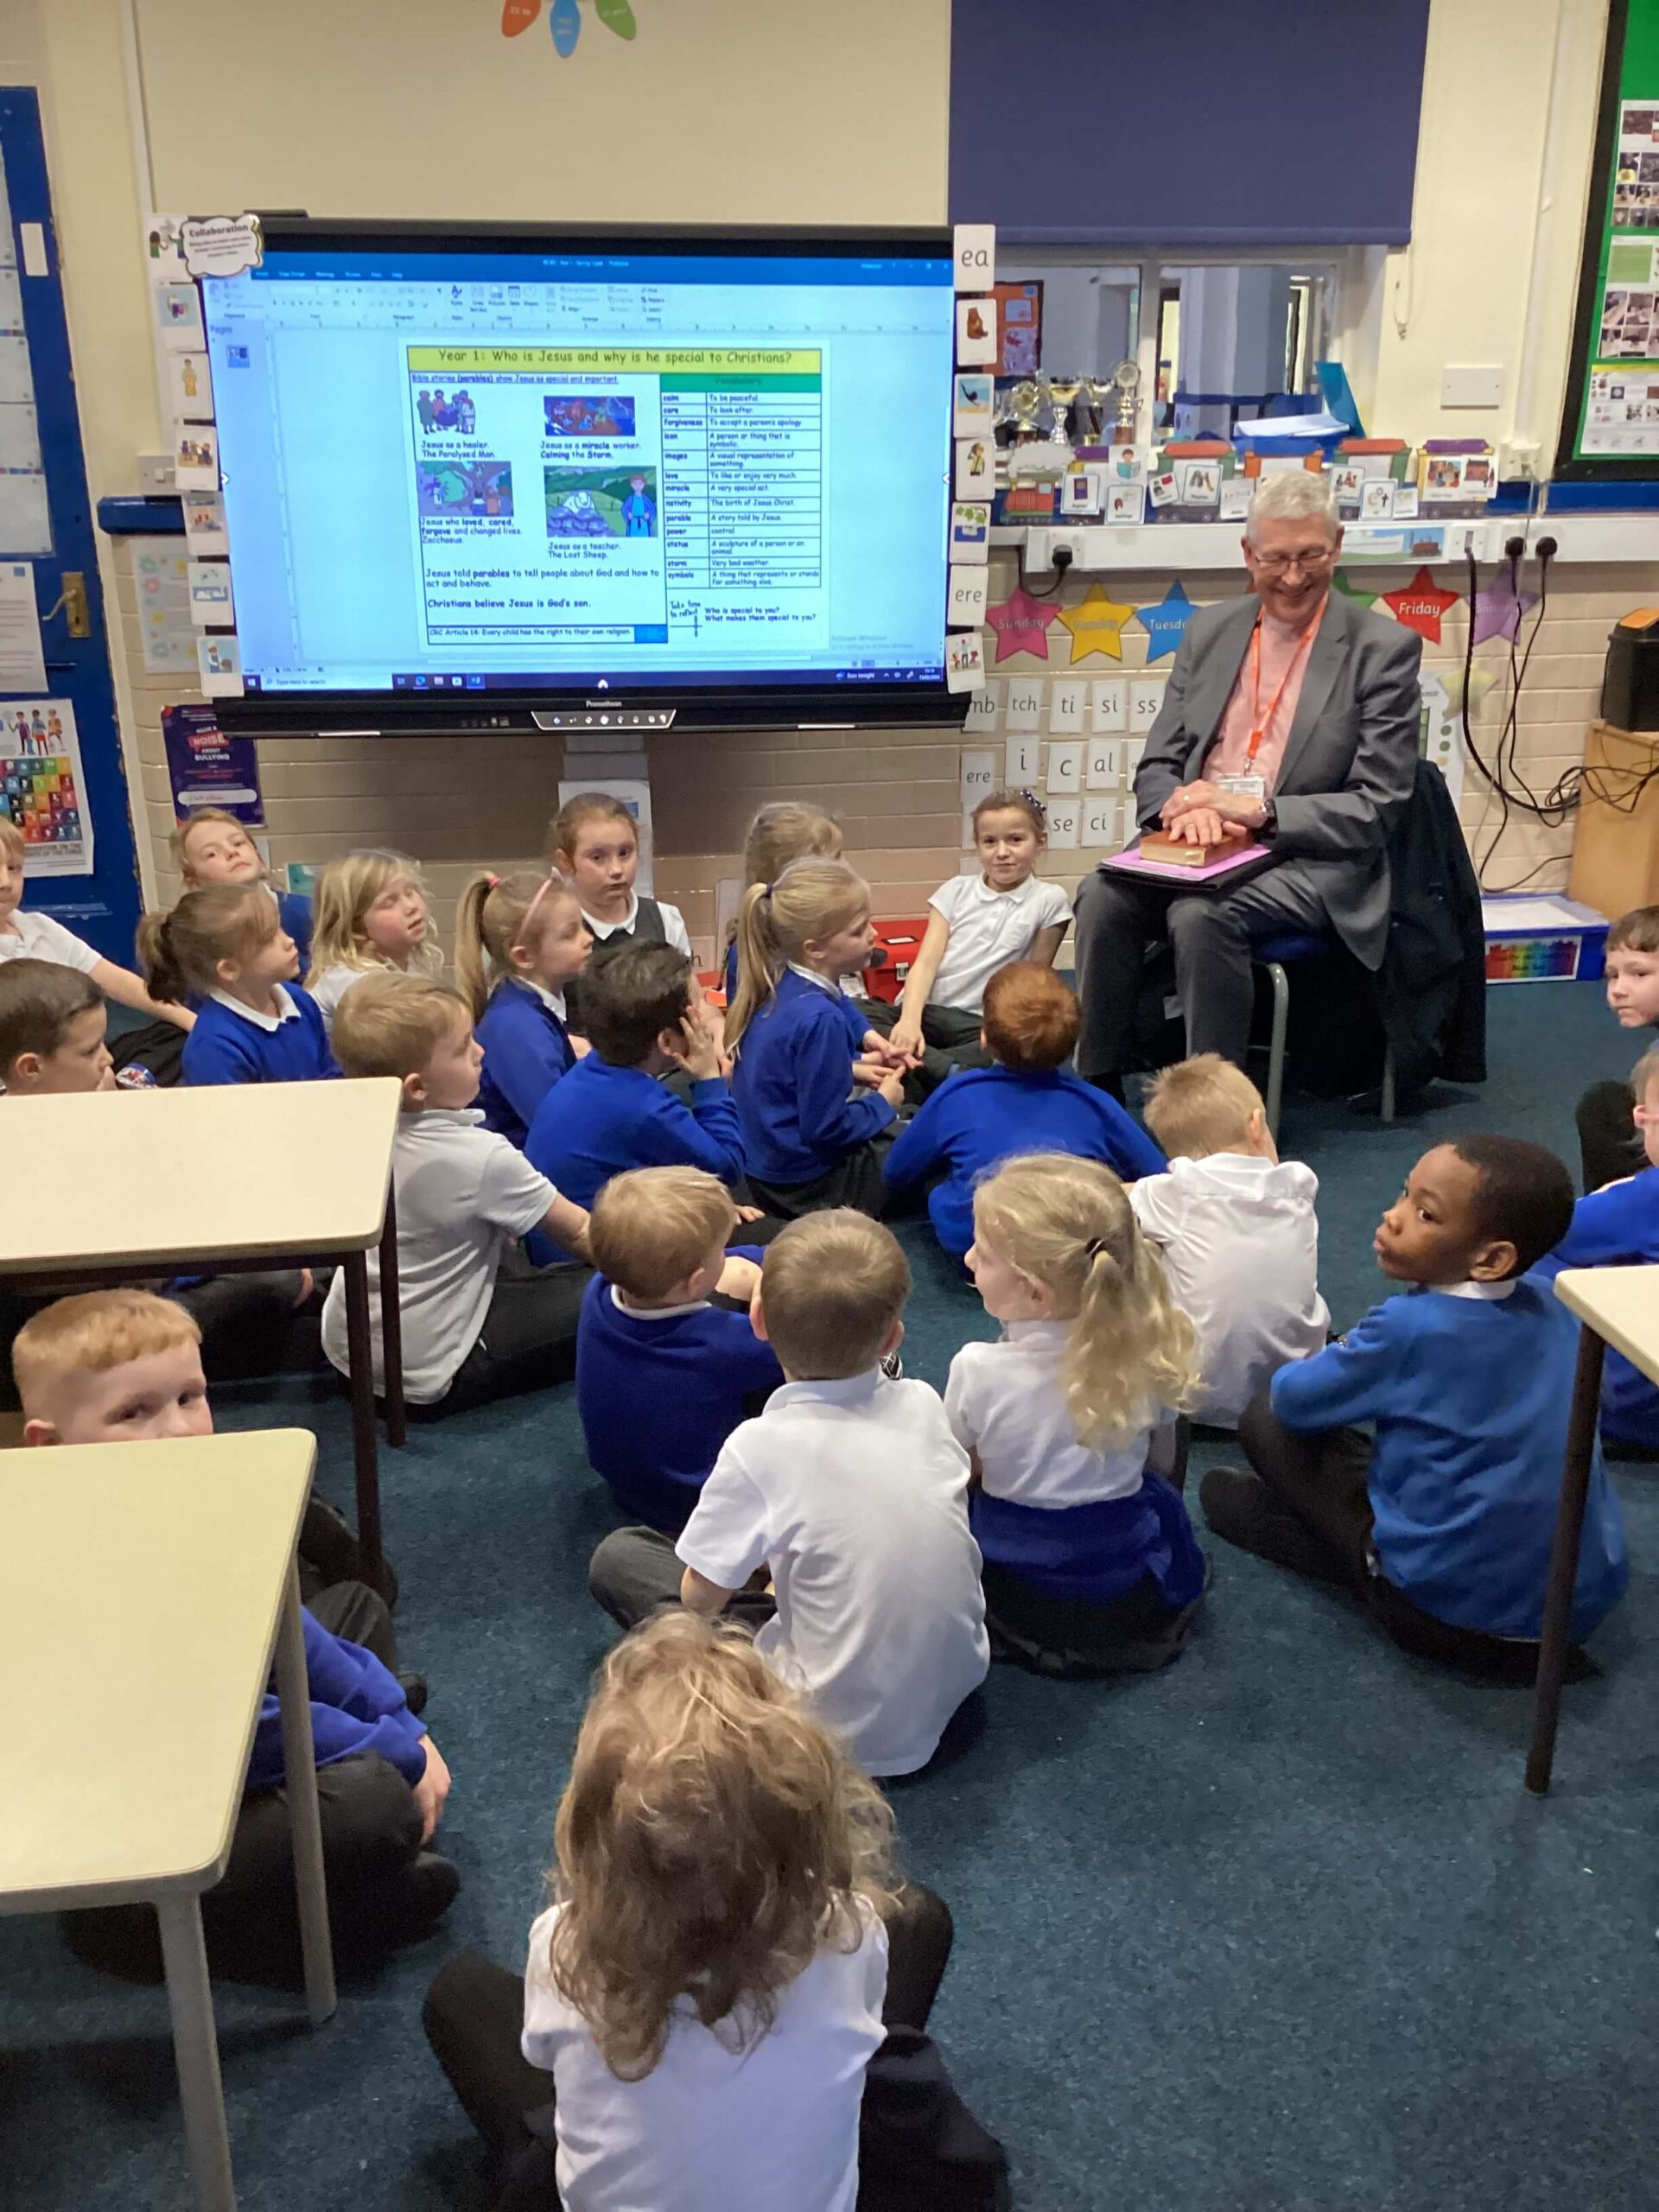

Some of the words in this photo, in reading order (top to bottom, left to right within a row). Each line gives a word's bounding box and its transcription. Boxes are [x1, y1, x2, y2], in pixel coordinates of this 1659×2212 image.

[188, 225, 248, 237] Collaboration
[962, 250, 989, 267] ea
[439, 350, 467, 362] Year
[493, 350, 518, 362] Who
[524, 350, 532, 362] is
[539, 350, 572, 362] Jesus
[578, 350, 598, 362] and
[604, 351, 626, 365] why
[632, 351, 640, 363] is
[647, 351, 659, 363] he
[665, 351, 704, 366] special
[710, 353, 721, 363] to
[728, 352, 791, 364] Christians?
[664, 419, 702, 428] forgiveness
[438, 450, 476, 460] Paralysed
[541, 450, 569, 460] Calming
[422, 527, 451, 536] forgave
[470, 527, 501, 536] changed
[549, 550, 562, 559] The
[564, 550, 580, 559] Lost
[426, 569, 450, 578] Jesus
[454, 569, 470, 578] told
[473, 569, 509, 579] parables
[512, 569, 521, 578] to
[524, 569, 538, 578] tell
[541, 569, 568, 579] people
[570, 569, 593, 578] about
[596, 569, 612, 578] God
[614, 569, 629, 578] and
[632, 569, 647, 578] how
[651, 569, 659, 578] to
[426, 579, 439, 588] act
[442, 579, 456, 588] and
[956, 589, 982, 602] ere
[1399, 601, 1440, 618] Friday
[998, 619, 1045, 630] Sunday
[1013, 696, 1036, 711] tch
[1062, 696, 1075, 714] ti
[1102, 695, 1118, 714] si
[1138, 699, 1156, 714] ss
[194, 733, 226, 746] NOISE
[966, 772, 990, 783] ere
[1094, 753, 1113, 772] al
[1052, 819, 1072, 831] se
[1090, 813, 1107, 830] ci
